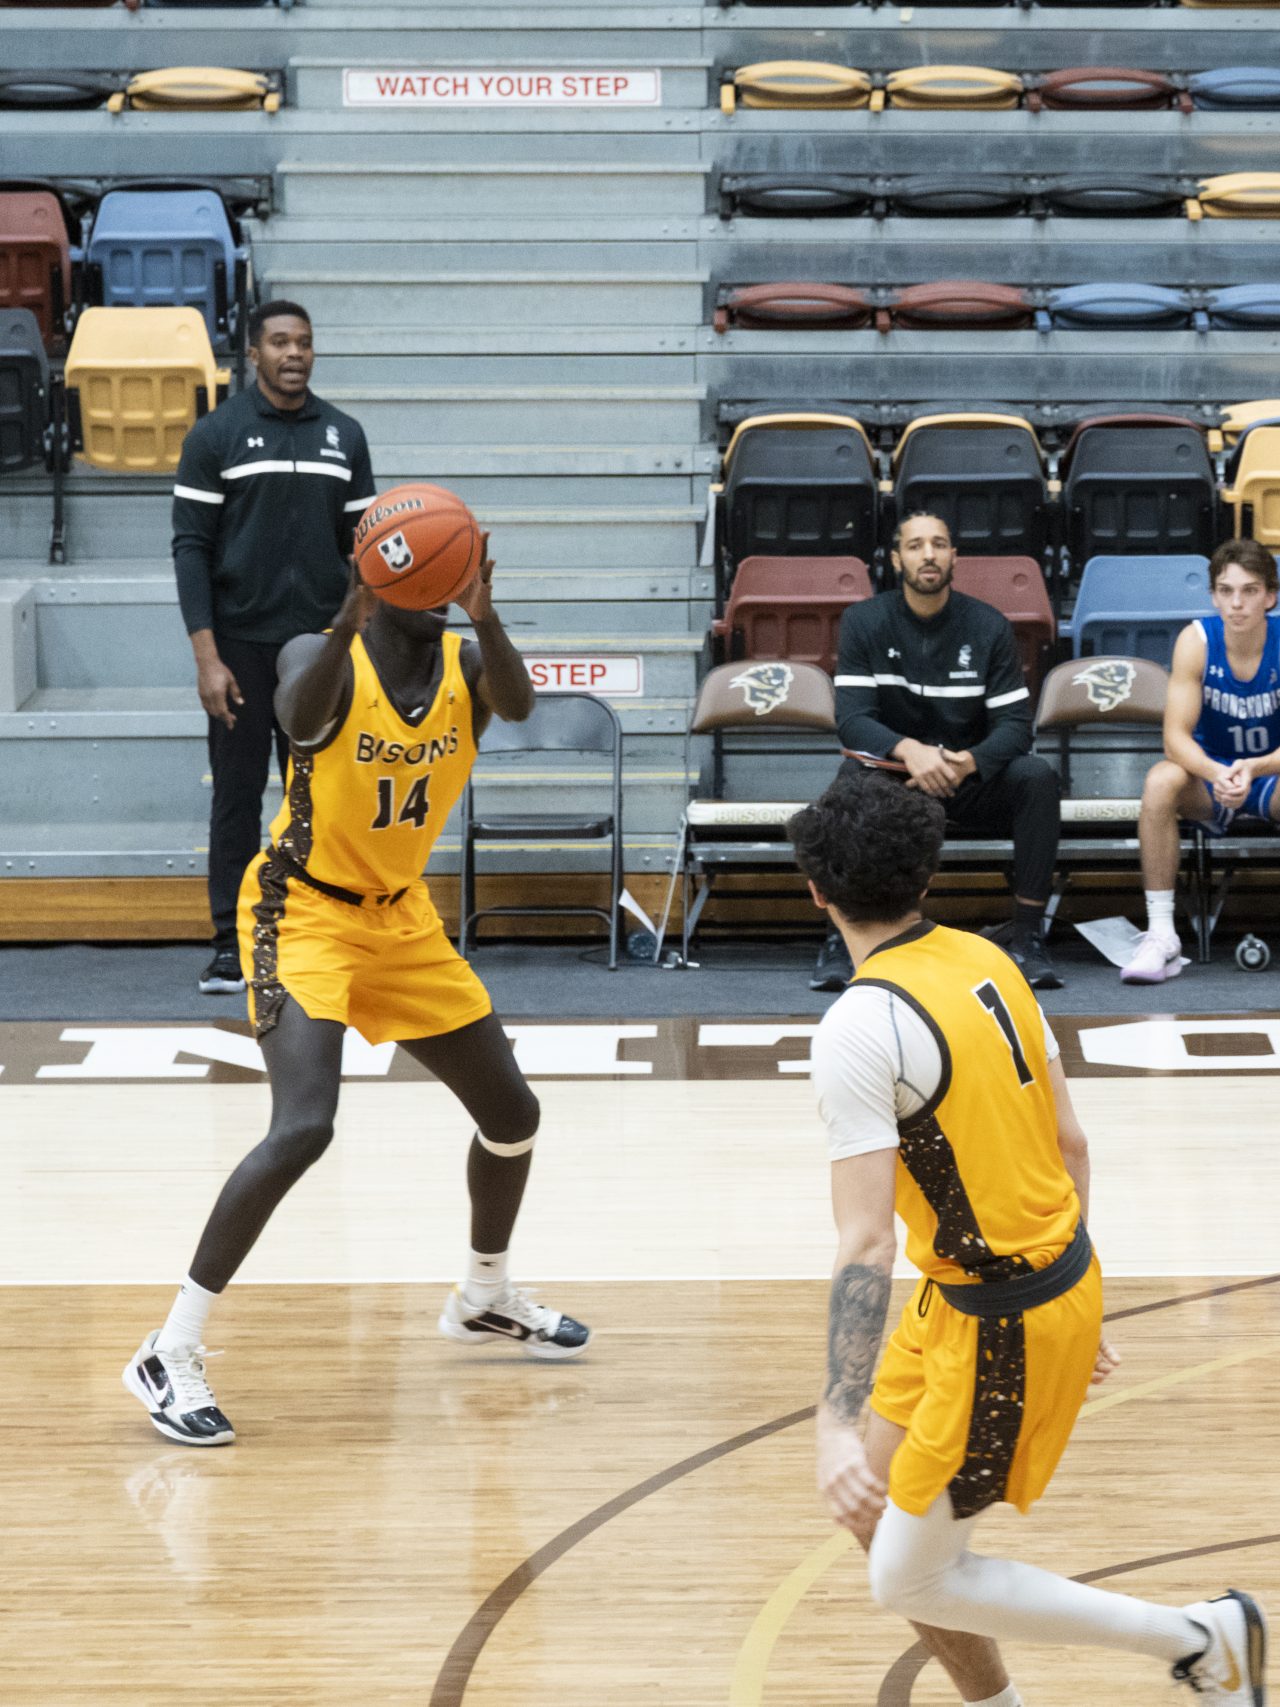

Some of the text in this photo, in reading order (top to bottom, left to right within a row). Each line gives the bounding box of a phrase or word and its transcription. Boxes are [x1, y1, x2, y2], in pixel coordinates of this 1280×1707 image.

[376, 76, 629, 97] WATCH YOUR STEP
[353, 498, 423, 544] Wilson
[530, 663, 607, 686] STEP
[354, 727, 458, 764] BISONS
[1227, 725, 1269, 753] 10
[369, 772, 433, 832] 14
[971, 977, 1036, 1089] 1
